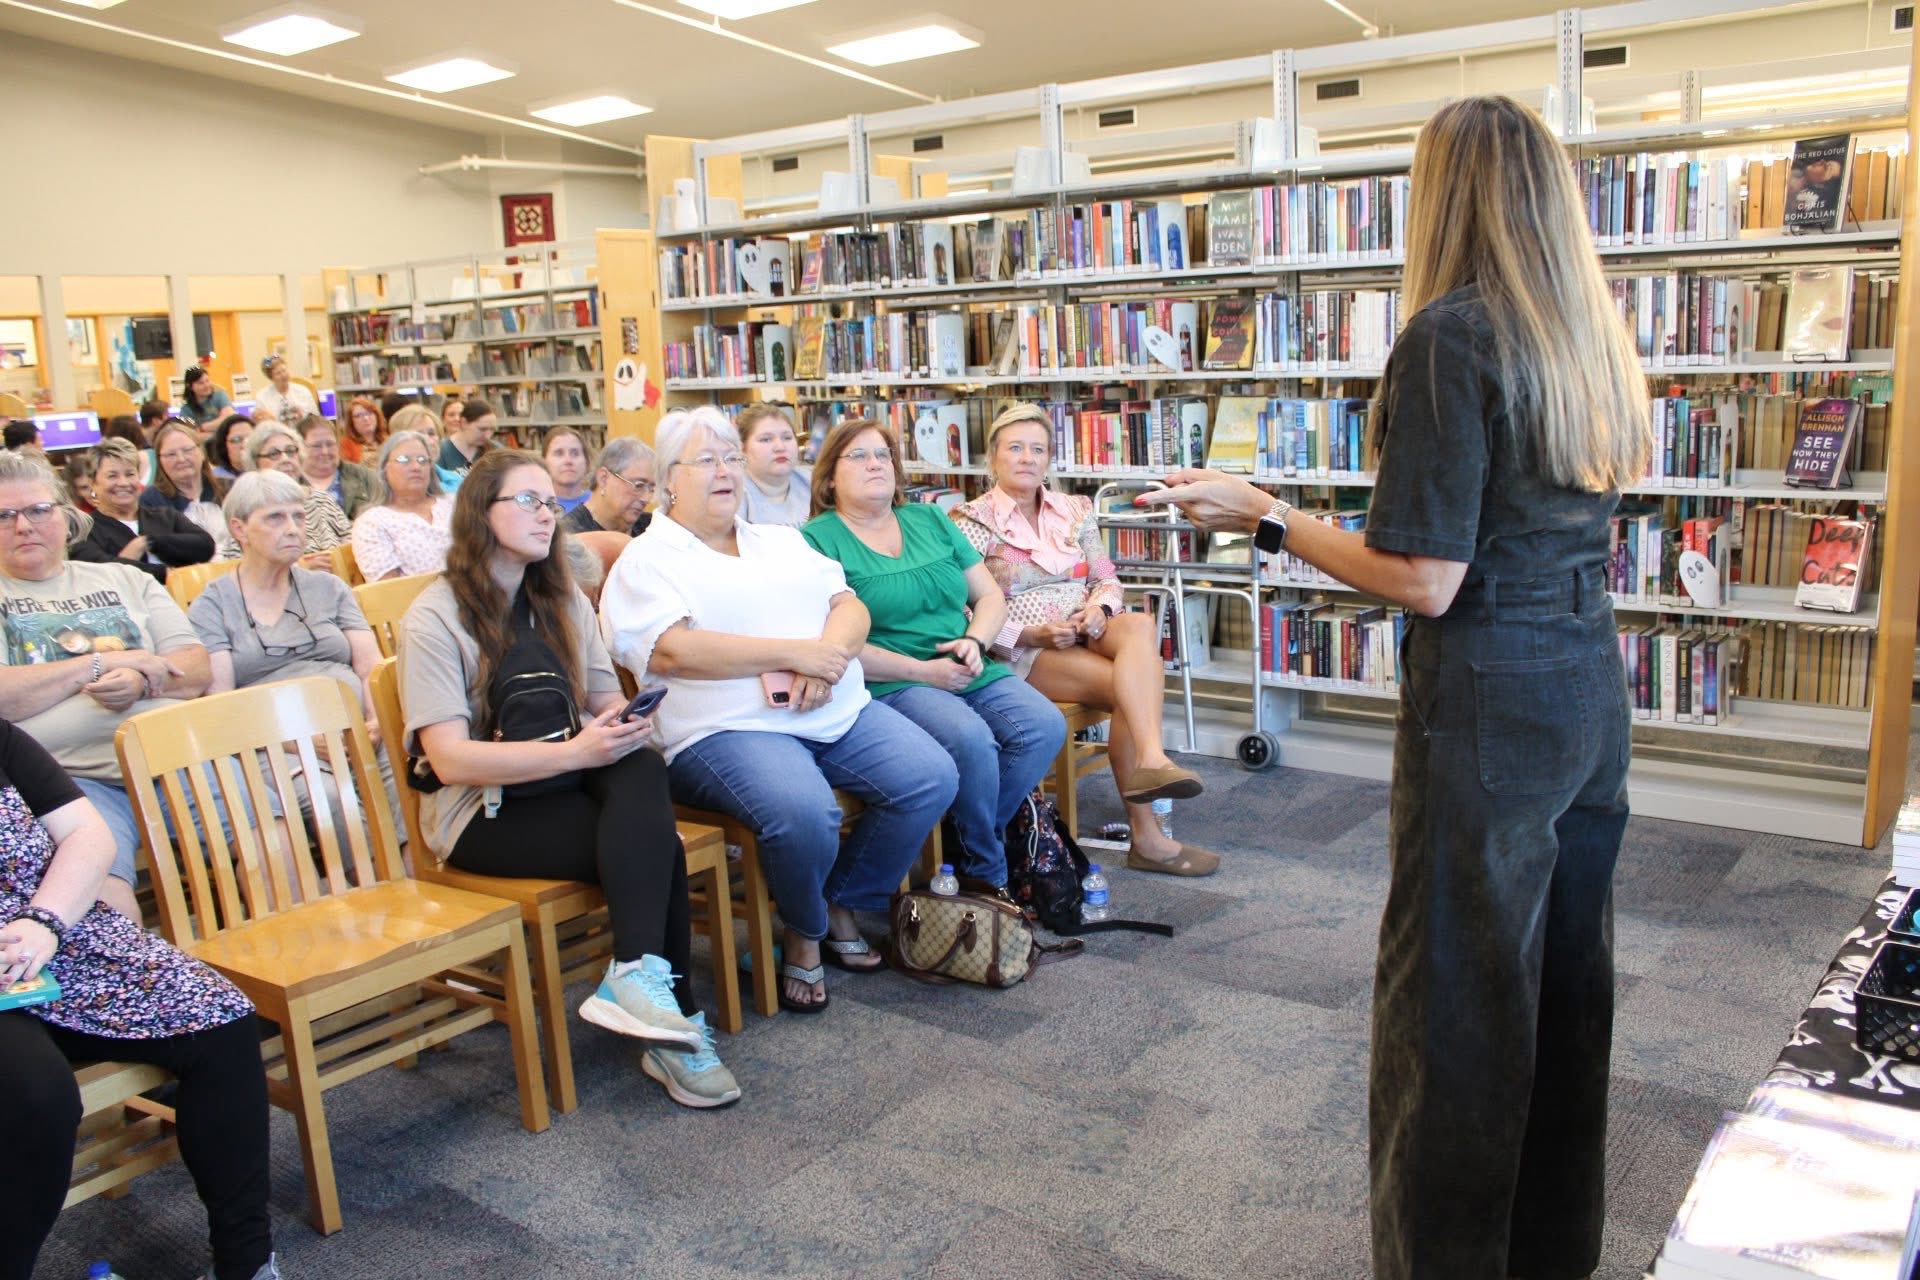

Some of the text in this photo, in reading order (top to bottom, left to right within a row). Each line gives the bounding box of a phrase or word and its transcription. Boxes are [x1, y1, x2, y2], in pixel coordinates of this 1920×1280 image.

[1808, 150, 1822, 159] RED
[1824, 147, 1845, 156] LOTUS
[1221, 202, 1239, 212] MY
[1797, 201, 1825, 210] CHRIS
[1212, 215, 1248, 225] NAME
[1785, 210, 1836, 222] BOHJALIAN
[1214, 242, 1246, 253] EDEN
[1807, 413, 1846, 422] ALLISON
[1801, 423, 1845, 433] BRENNAN
[1803, 436, 1834, 450] SEE
[1792, 450, 1839, 459] HOW THEY
[1794, 459, 1830, 472] HIDE
[49, 600, 81, 613] THE
[80, 590, 122, 608] WILD
[1664, 638, 1673, 686] IRON GOLD
